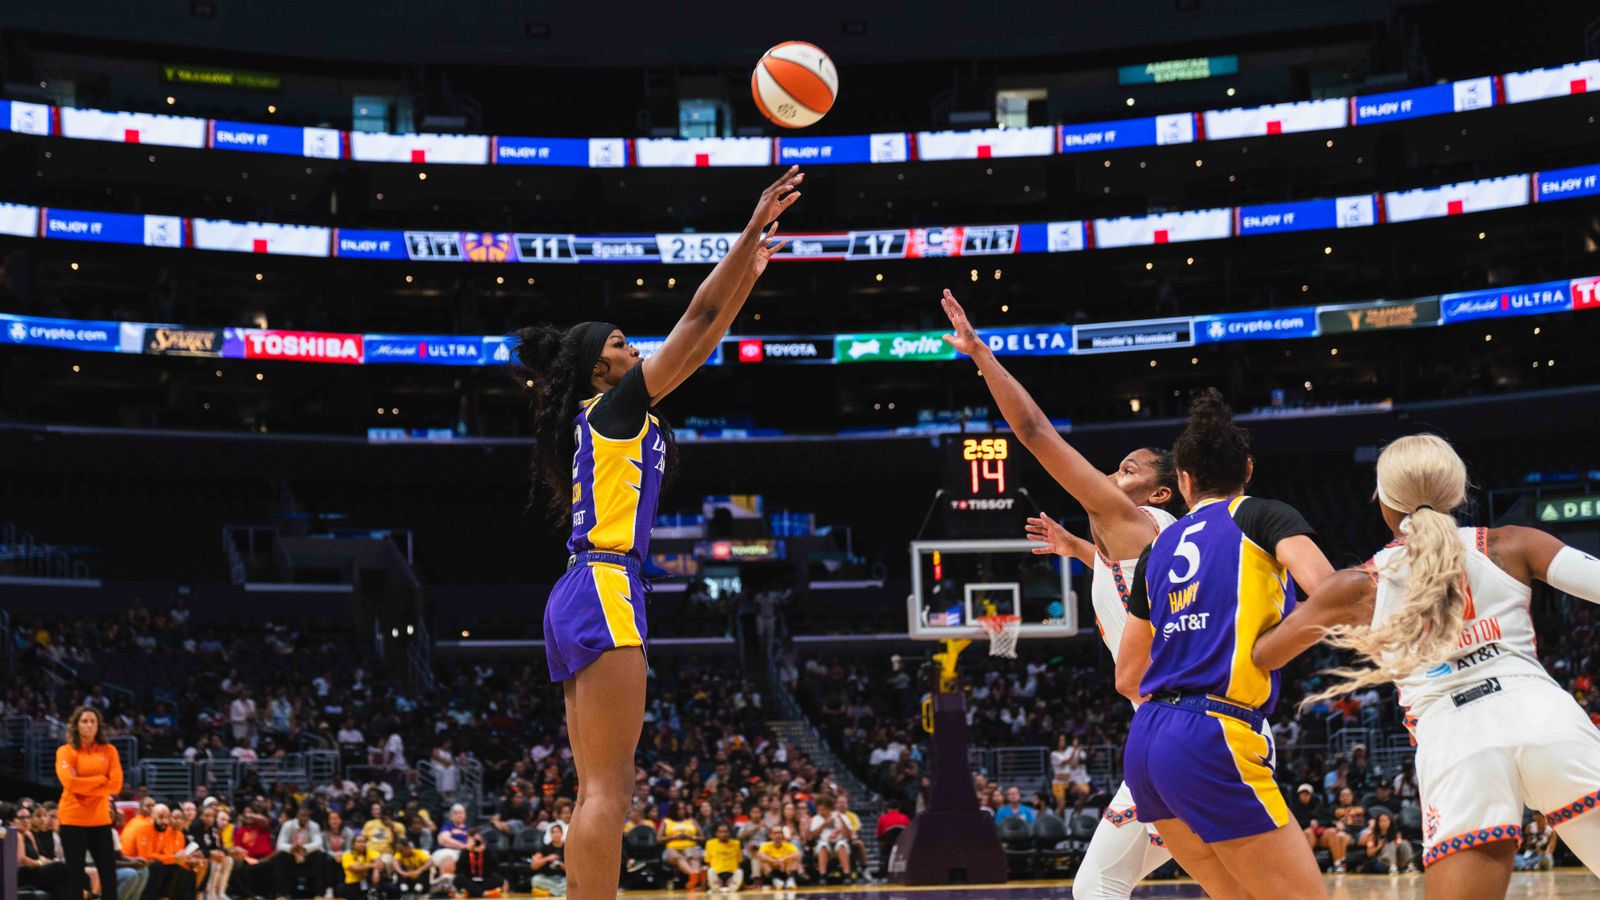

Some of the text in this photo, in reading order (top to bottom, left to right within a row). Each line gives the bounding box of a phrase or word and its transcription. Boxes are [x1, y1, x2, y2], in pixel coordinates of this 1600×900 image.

[1359, 100, 1412, 118] ENJOY IT
[216, 130, 268, 146] ENJOY IT
[1064, 130, 1116, 146] ENJOY IT
[499, 146, 549, 159] ENJOY IT
[782, 146, 832, 159] ENJOY IT
[1542, 174, 1597, 193] ENJOY IT
[49, 218, 103, 234] ENJOY IT
[1243, 212, 1295, 228] ENJOY IT
[341, 239, 390, 251] ENJOY IT
[531, 238, 559, 258] 11
[592, 240, 645, 259] Sparks
[671, 238, 730, 258] 2:59
[791, 240, 824, 256] Sun
[864, 235, 895, 256] 17
[1511, 290, 1564, 307] ULTRA
[1227, 317, 1304, 334] crypto.com
[29, 327, 107, 342] crypto.com
[989, 333, 1066, 352] DELTA
[250, 334, 359, 358] TOSHIBA
[428, 344, 477, 357] ULTRA
[764, 343, 817, 356] TOYOTA
[889, 335, 943, 358] Sprite
[963, 438, 1008, 460] 2:59
[971, 459, 1006, 494] 14
[968, 499, 1014, 510] TISSOT
[1168, 521, 1207, 583] 5
[1457, 642, 1501, 671] AT&T
